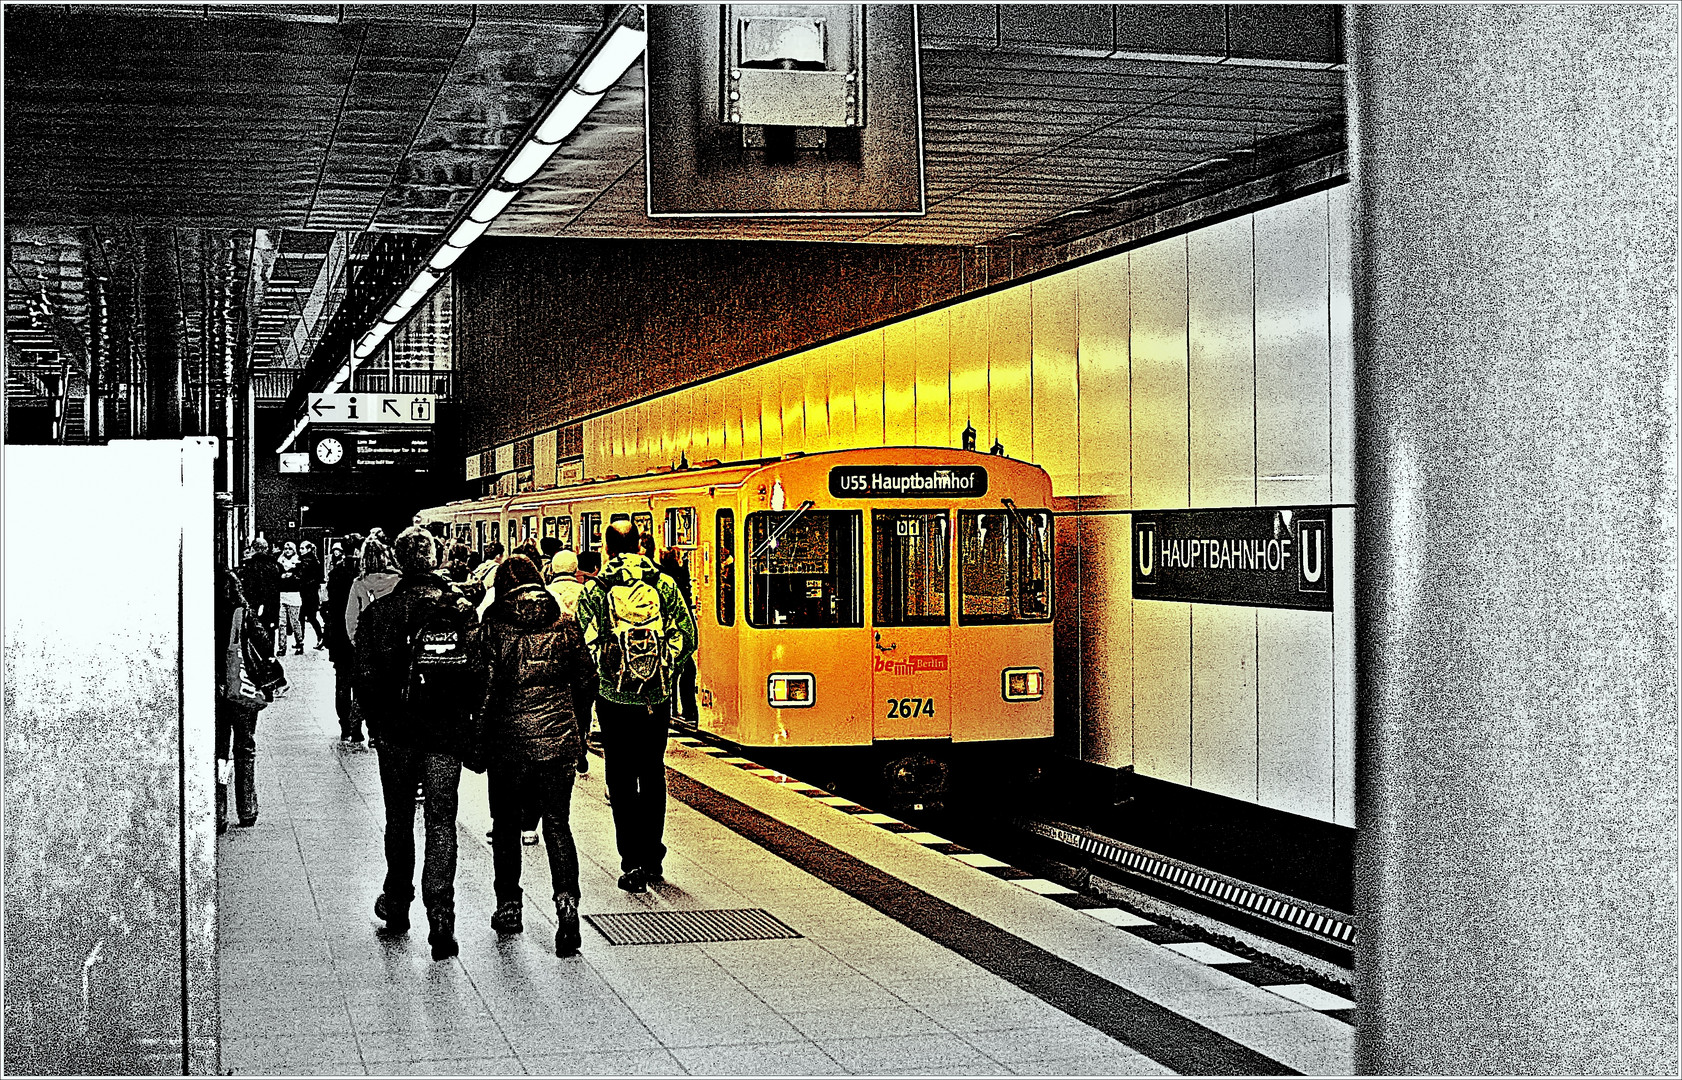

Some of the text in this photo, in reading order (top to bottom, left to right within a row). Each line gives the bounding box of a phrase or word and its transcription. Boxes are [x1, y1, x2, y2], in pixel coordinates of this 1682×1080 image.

[841, 472, 975, 493] U55 Hauptbahnhof
[1139, 529, 1322, 582] U HAUPTBAHNHOF U
[887, 698, 935, 718] 2674
